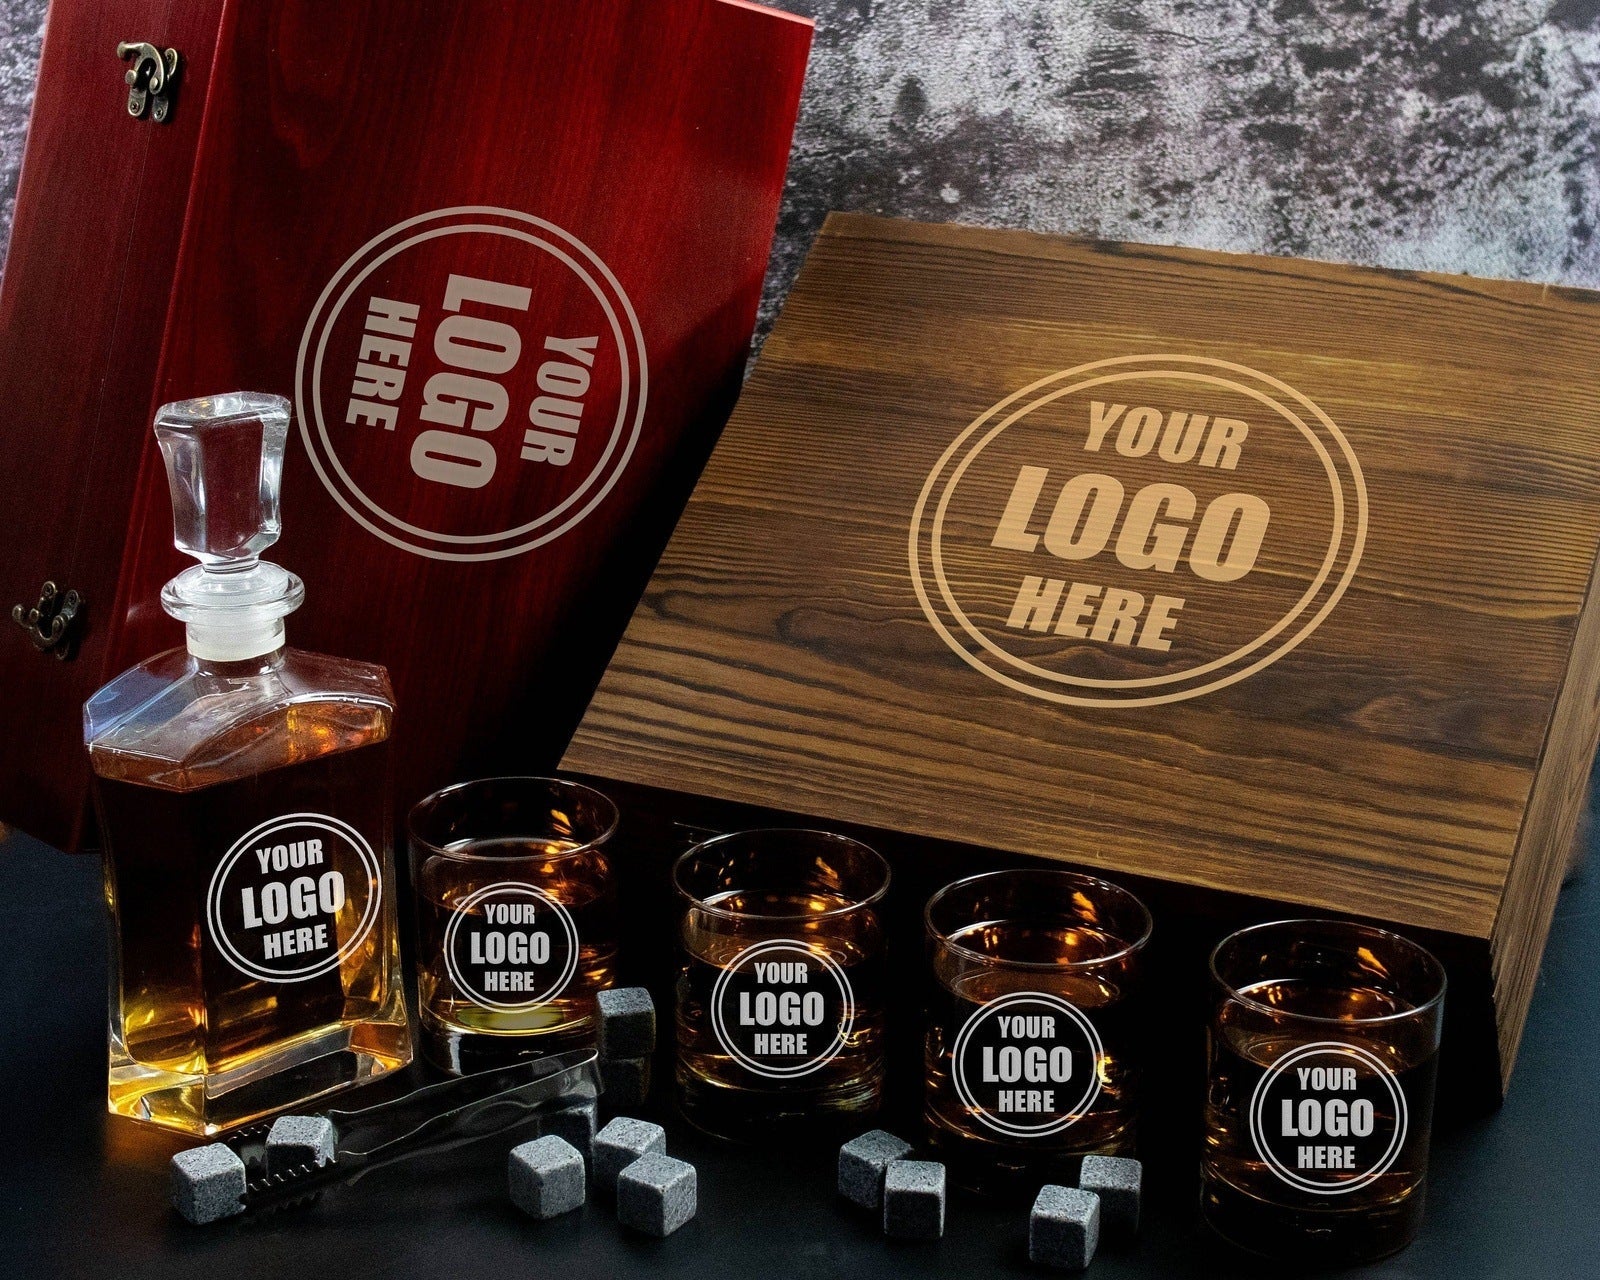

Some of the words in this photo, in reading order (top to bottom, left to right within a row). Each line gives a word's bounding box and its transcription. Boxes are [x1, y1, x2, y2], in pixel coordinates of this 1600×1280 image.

[345, 296, 420, 431] HERE
[410, 274, 532, 489] LOGO
[520, 336, 599, 467] YOUR
[1084, 401, 1248, 470] YOUR
[991, 465, 1271, 581] LOGO
[1007, 575, 1185, 651] HERE
[255, 838, 323, 874] YOUR
[241, 870, 346, 930] LOGO
[484, 904, 536, 925] YOUR
[263, 924, 328, 960] HERE
[470, 931, 551, 964] LOGO
[484, 971, 535, 992] HERE
[754, 962, 808, 984] YOUR
[739, 991, 825, 1026] LOGO
[754, 1033, 807, 1055] HERE
[998, 1016, 1055, 1039] YOUR
[982, 1046, 1072, 1083] LOGO
[1296, 1067, 1357, 1091] YOUR
[998, 1090, 1055, 1113] HERE
[1281, 1098, 1374, 1138] LOGO
[1297, 1145, 1356, 1169] HERE
